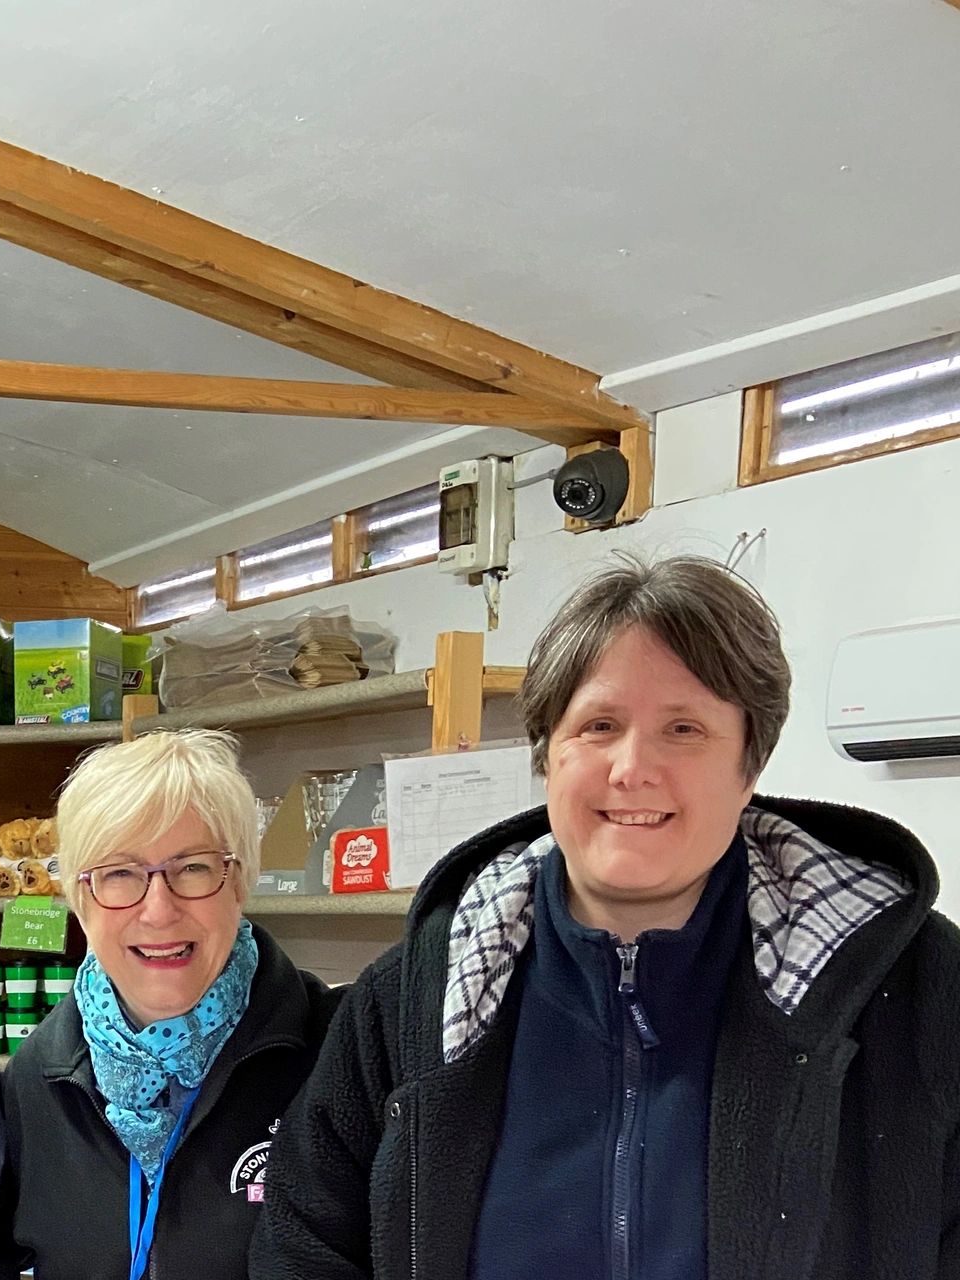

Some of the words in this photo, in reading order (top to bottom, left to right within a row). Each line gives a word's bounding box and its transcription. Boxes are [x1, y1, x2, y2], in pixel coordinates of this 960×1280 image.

[61, 706, 90, 719] COUNTRY
[348, 841, 373, 853] Animal
[346, 853, 372, 863] Dreams
[277, 879, 298, 893] Large
[342, 874, 374, 886] SAWDUST
[11, 905, 61, 918] Stonebridge
[24, 921, 44, 930] Bear
[27, 936, 38, 945] £6
[239, 1151, 270, 1180] STON
